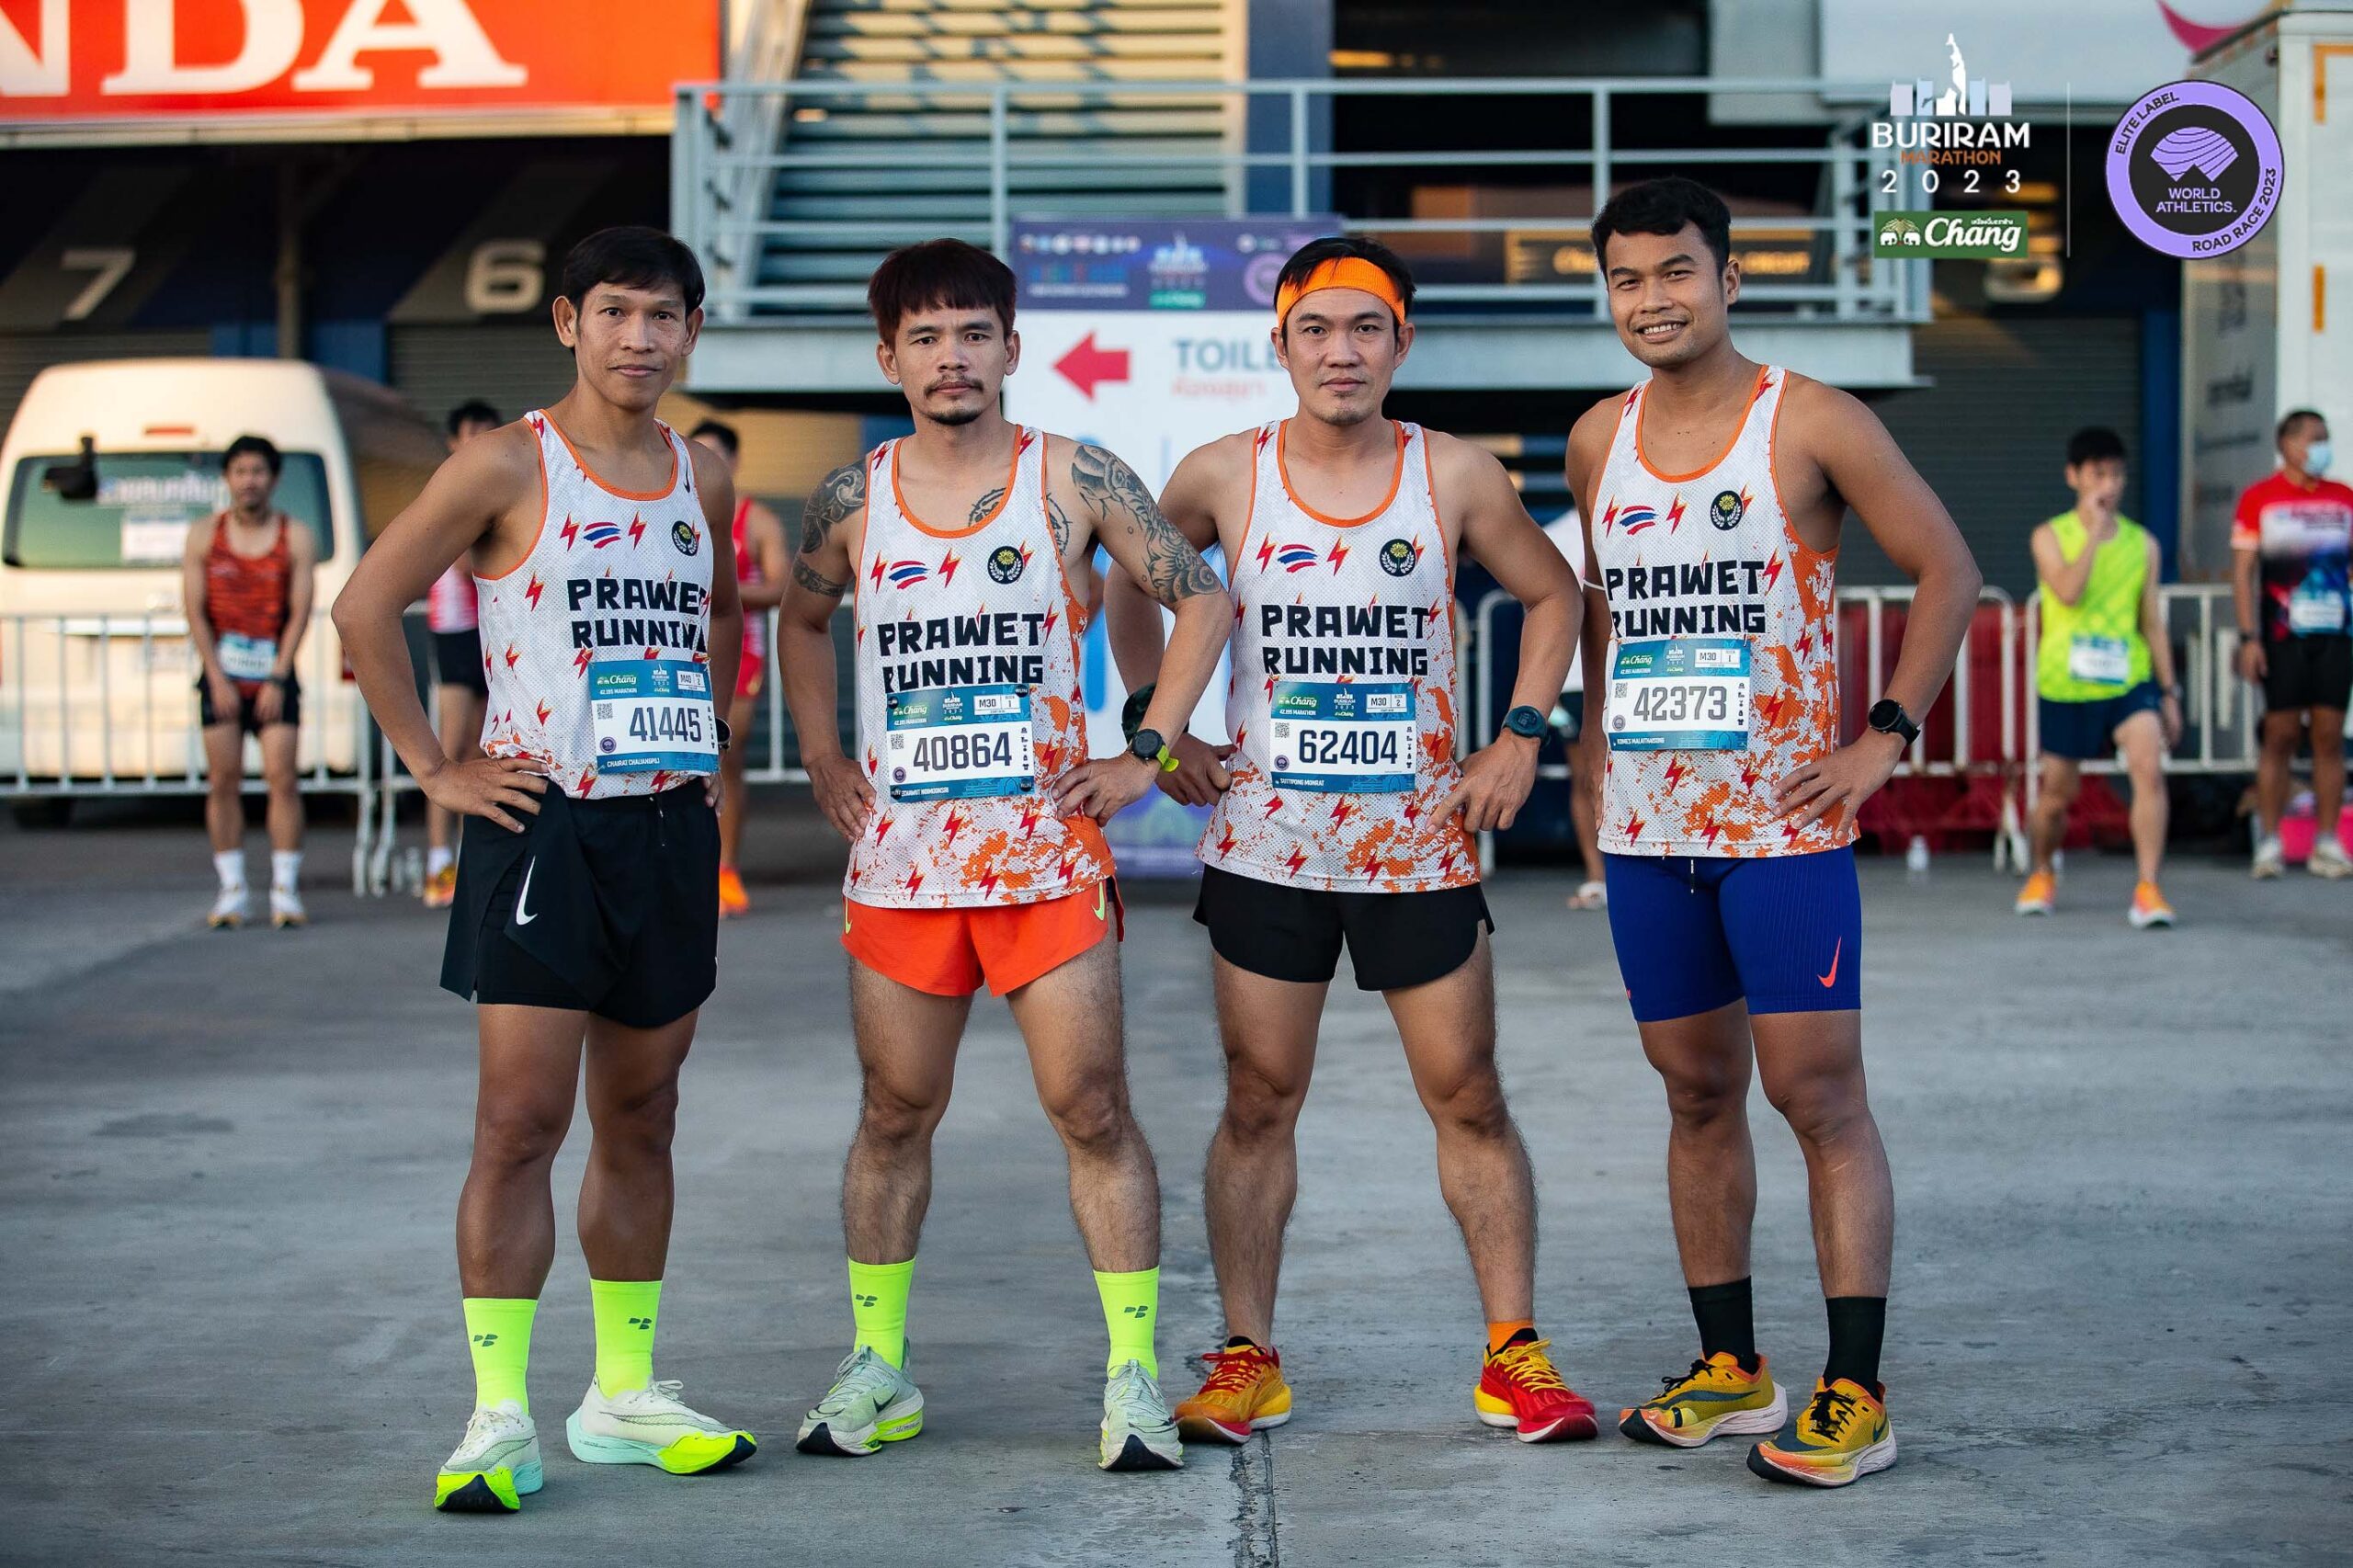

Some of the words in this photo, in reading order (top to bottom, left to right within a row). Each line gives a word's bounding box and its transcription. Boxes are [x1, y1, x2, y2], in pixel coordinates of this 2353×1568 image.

[62, 248, 135, 320] 7
[467, 240, 545, 312] 6
[1606, 560, 1765, 600] PRAWET
[877, 612, 1045, 656] PRAWET
[1261, 604, 1429, 639] PRAWET
[1611, 604, 1766, 638] RUNNING
[882, 655, 1043, 693] RUNNING
[1262, 646, 1428, 676] RUNNING
[1630, 654, 1654, 665] Chang
[1699, 652, 1716, 661] M30
[609, 675, 637, 685] Chang
[904, 705, 927, 714] Chang
[979, 699, 996, 708] M30
[1290, 696, 1317, 708] Chang
[1370, 698, 1387, 706] M30
[1633, 686, 1727, 722] 42373
[629, 707, 702, 743] 41445
[913, 732, 1012, 772] 40864
[1299, 729, 1398, 765] 62404
